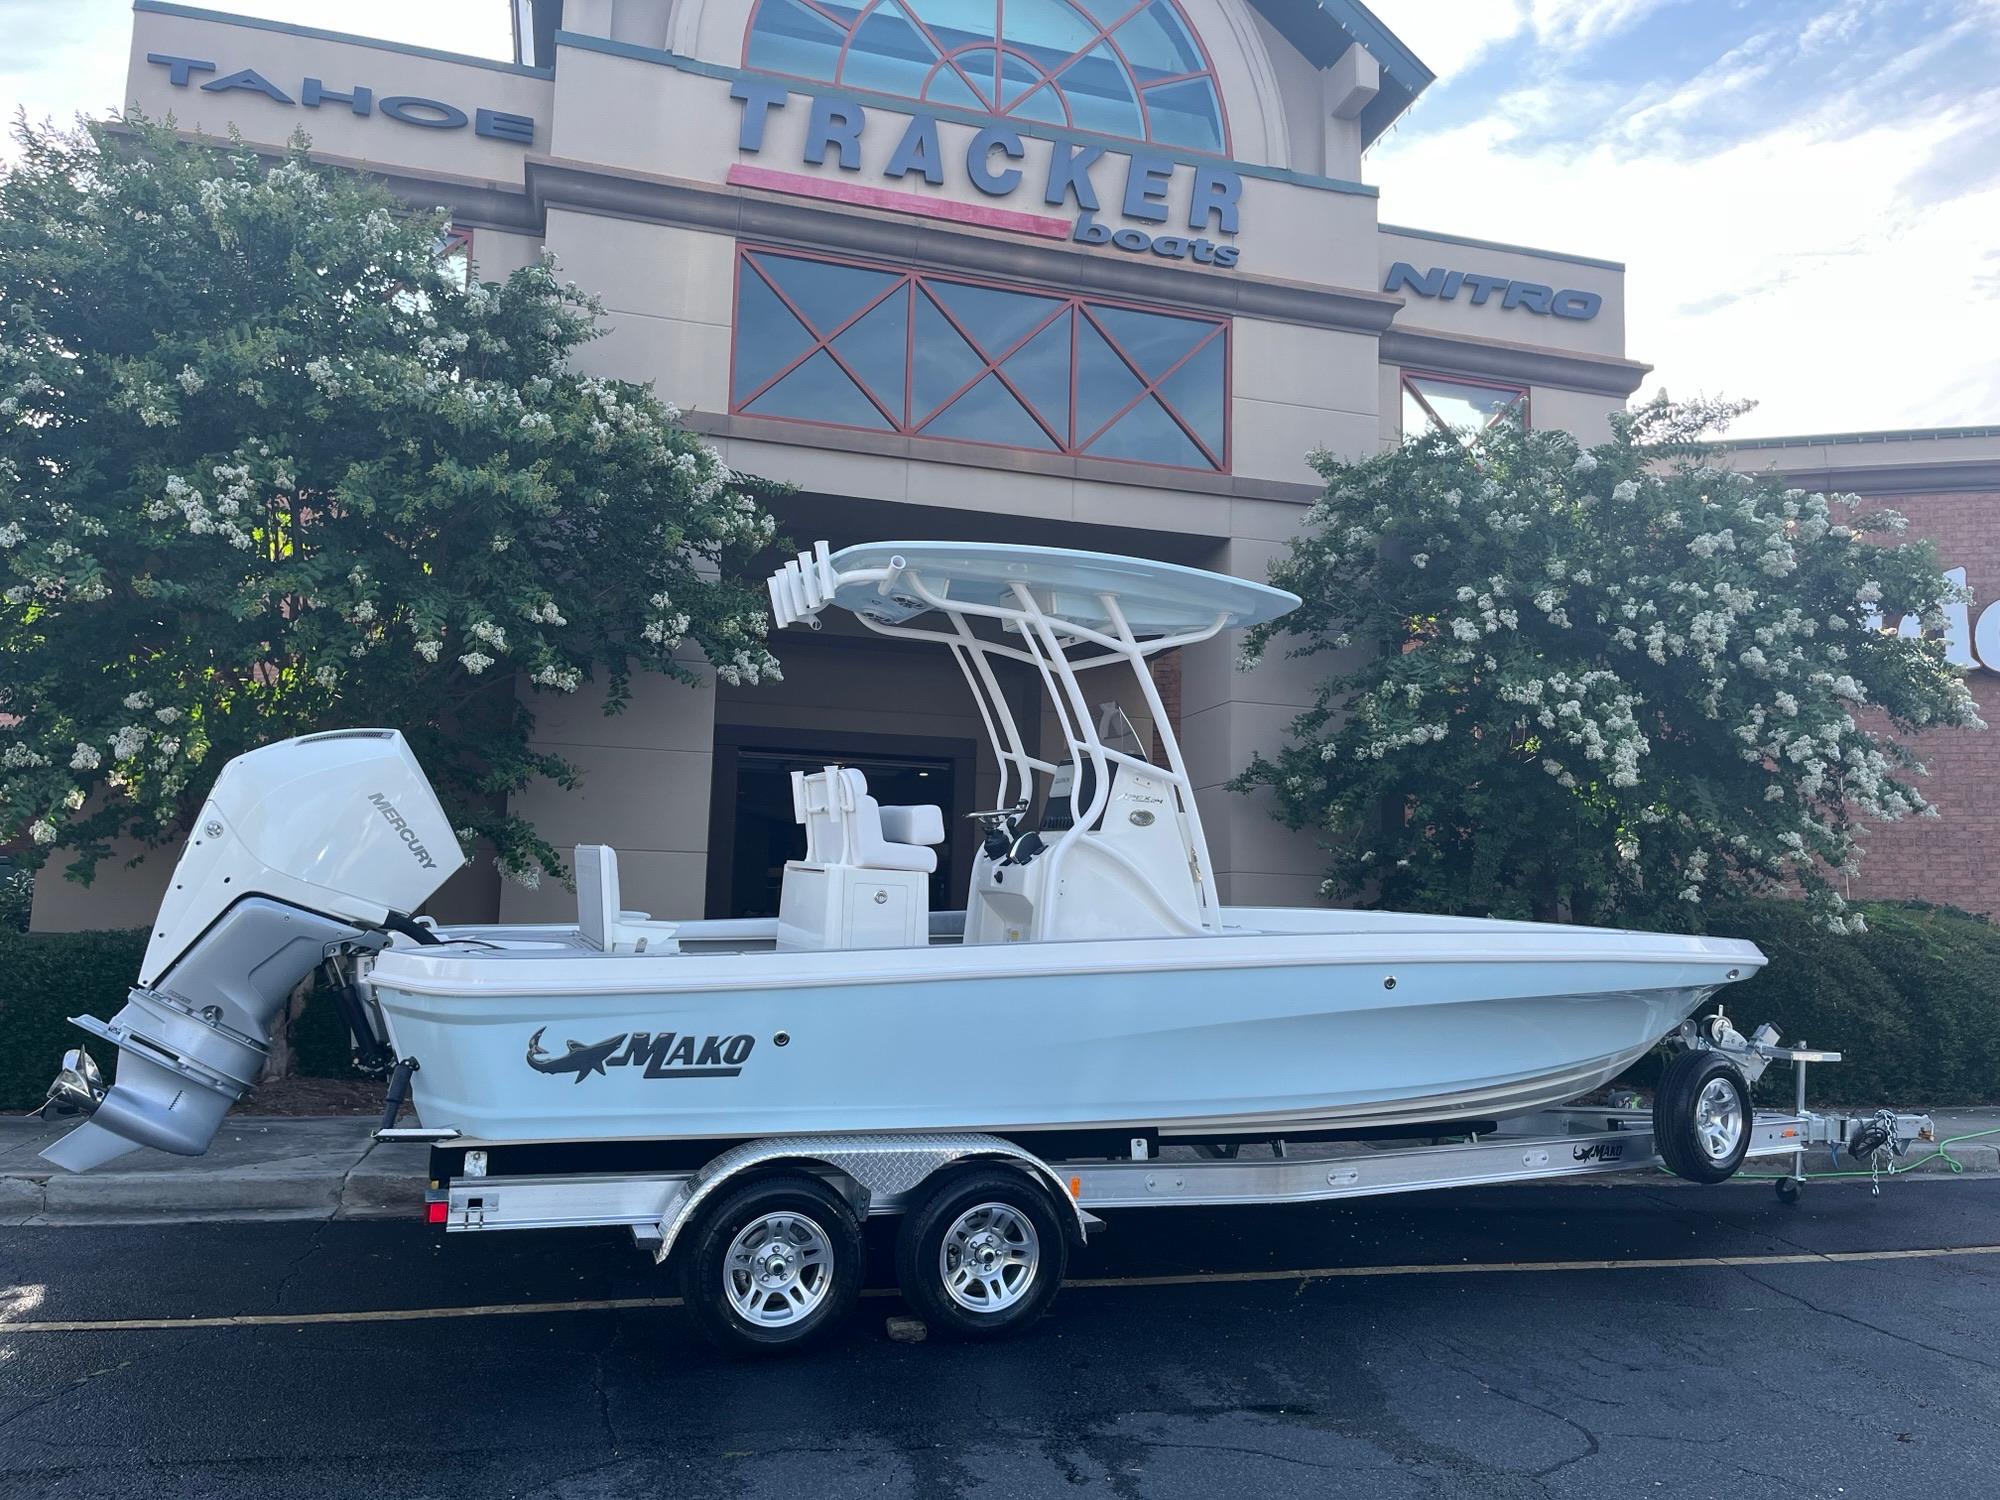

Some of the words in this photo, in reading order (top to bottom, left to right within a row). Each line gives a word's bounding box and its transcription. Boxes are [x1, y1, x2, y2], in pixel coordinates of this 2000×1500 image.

[147, 52, 534, 145] TAHOE
[730, 80, 1243, 234] TRACKER
[1072, 213, 1240, 267] boats
[1383, 261, 1602, 321] NITRO
[367, 792, 437, 869] MERCURY
[604, 1031, 756, 1079] MAKO
[1590, 1144, 1623, 1162] MAKO
